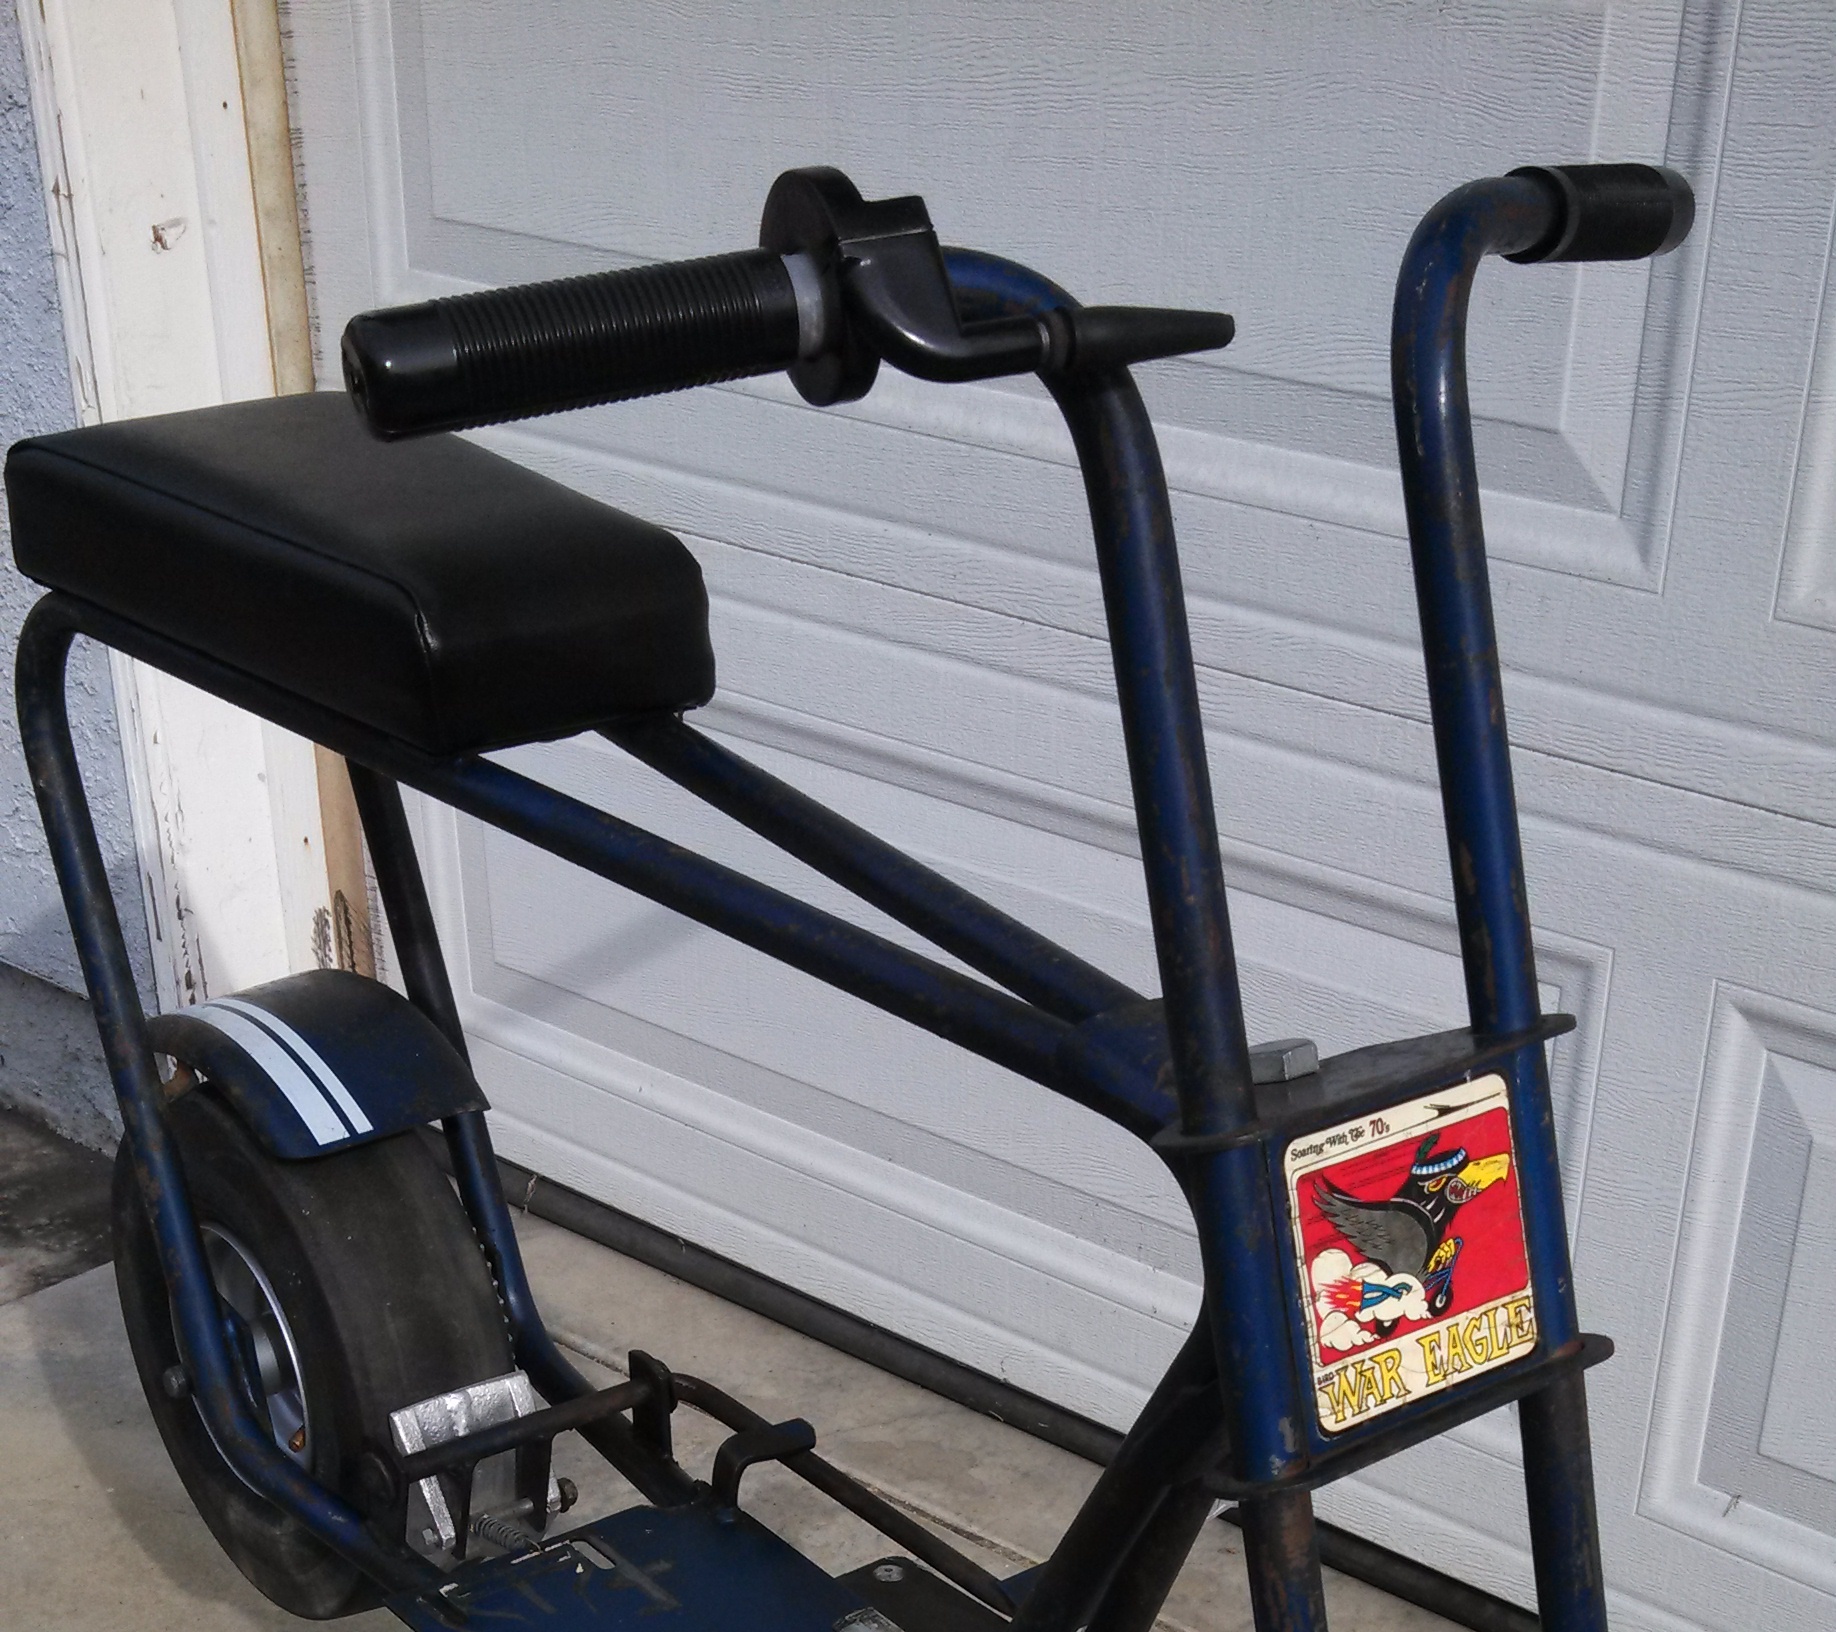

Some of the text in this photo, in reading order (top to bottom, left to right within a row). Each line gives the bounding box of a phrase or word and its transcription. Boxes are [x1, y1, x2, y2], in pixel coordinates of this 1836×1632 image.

[1290, 1117, 1390, 1162] Soaring With The 70's
[1318, 1296, 1535, 1424] WAR EAGLE
